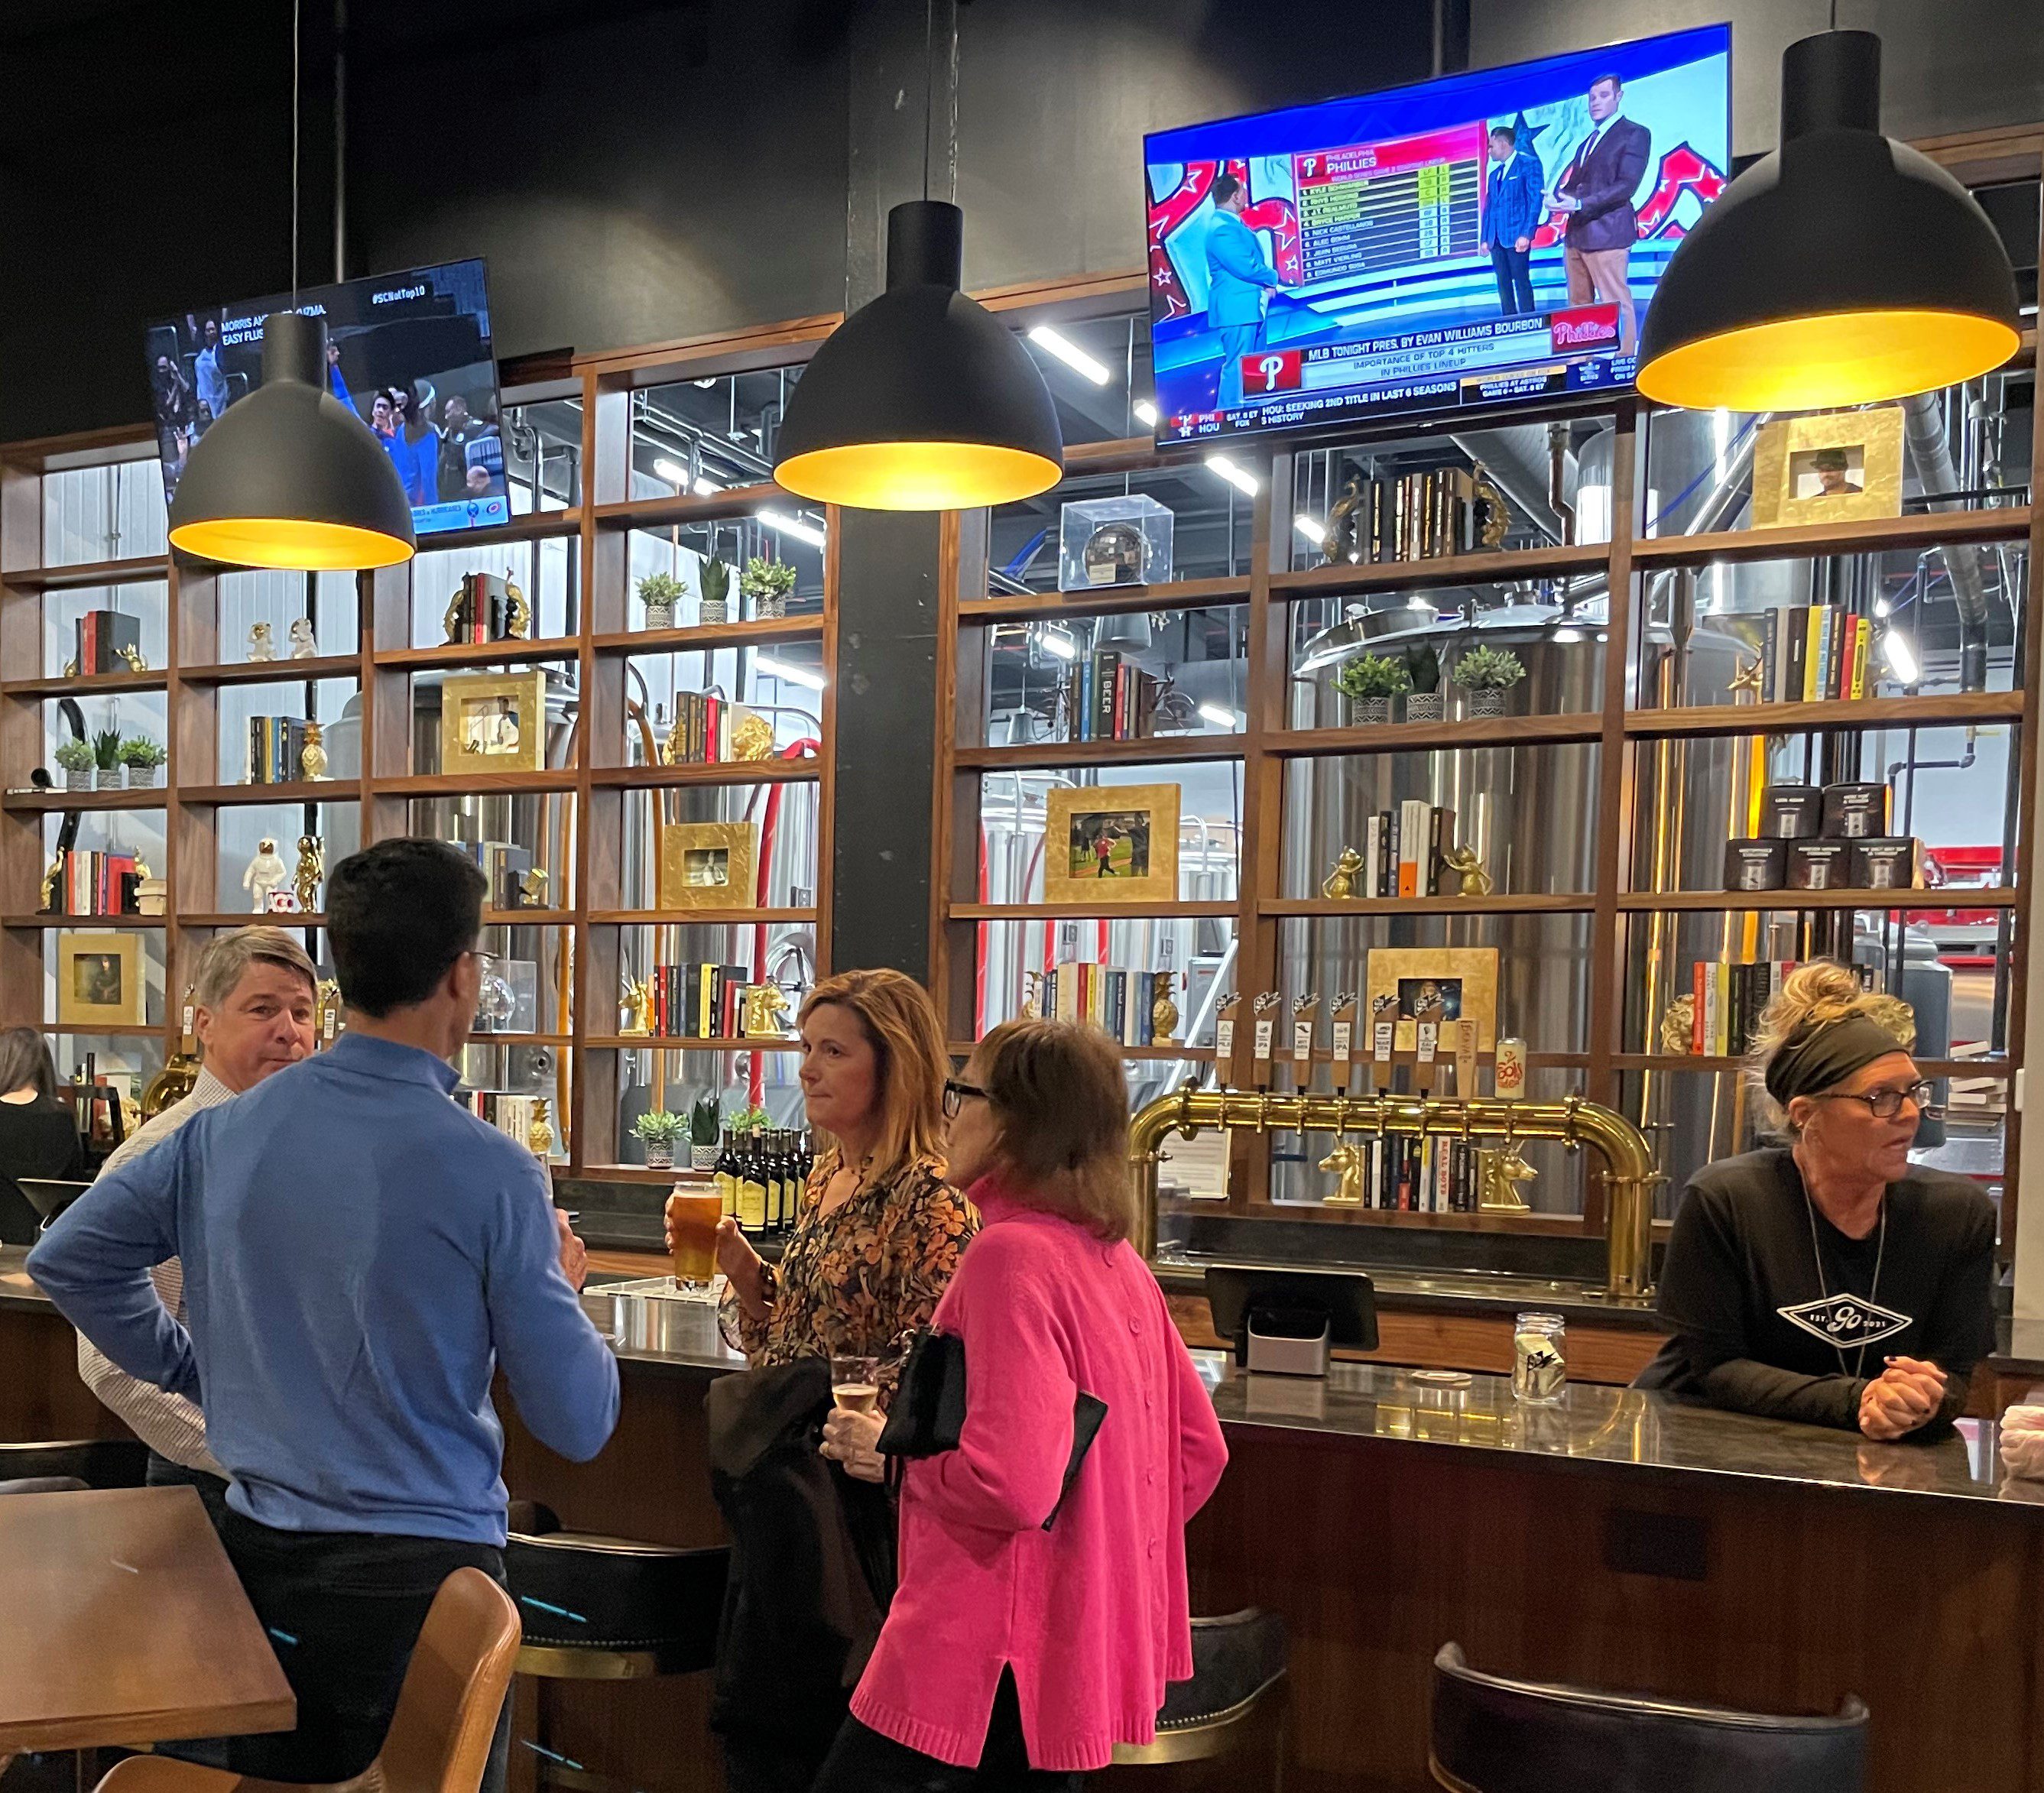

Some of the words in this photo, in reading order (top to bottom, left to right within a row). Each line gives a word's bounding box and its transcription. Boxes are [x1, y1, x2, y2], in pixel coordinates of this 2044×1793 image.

[1327, 157, 1377, 174] PHILLIES
[1313, 258, 1332, 267] MATT
[221, 317, 252, 332] MORRIS
[222, 332, 244, 346] EASY
[1308, 348, 1330, 362] MLB
[1332, 342, 1371, 358] TONIGHT
[1372, 338, 1399, 352] PRES.
[1401, 336, 1414, 349] BY
[1416, 332, 1442, 346] EVAN
[1444, 324, 1492, 342] WILLIAMS
[1494, 317, 1543, 335] BOURBON
[1552, 321, 1617, 345] Phillies
[1353, 353, 1410, 369] IMPORTANCE
[1413, 352, 1425, 362] OF
[1428, 349, 1445, 359] TOP
[1448, 348, 1454, 357] 4
[1457, 343, 1494, 355] HITTERS
[1259, 355, 1284, 391] P
[1381, 368, 1390, 377] IN
[1393, 362, 1431, 375] PHILLIES
[1434, 358, 1466, 370] LINEUP
[1261, 405, 1285, 416] HOU:
[1286, 399, 1324, 413] SEEKING
[1325, 397, 1344, 407] 2ND
[1345, 393, 1368, 405] TITLE
[1370, 391, 1381, 402] IN
[1381, 387, 1405, 400] LAST
[1405, 387, 1412, 397] 6
[1413, 381, 1457, 397] SEASONS
[1199, 413, 1215, 423] PHI
[1248, 410, 1259, 420] ET
[1267, 411, 1304, 424] HISTORY
[1199, 423, 1220, 433] HOU
[1235, 420, 1250, 428] FOX
[1101, 680, 1113, 714] BEER
[1809, 1314, 1829, 1324] EST.
